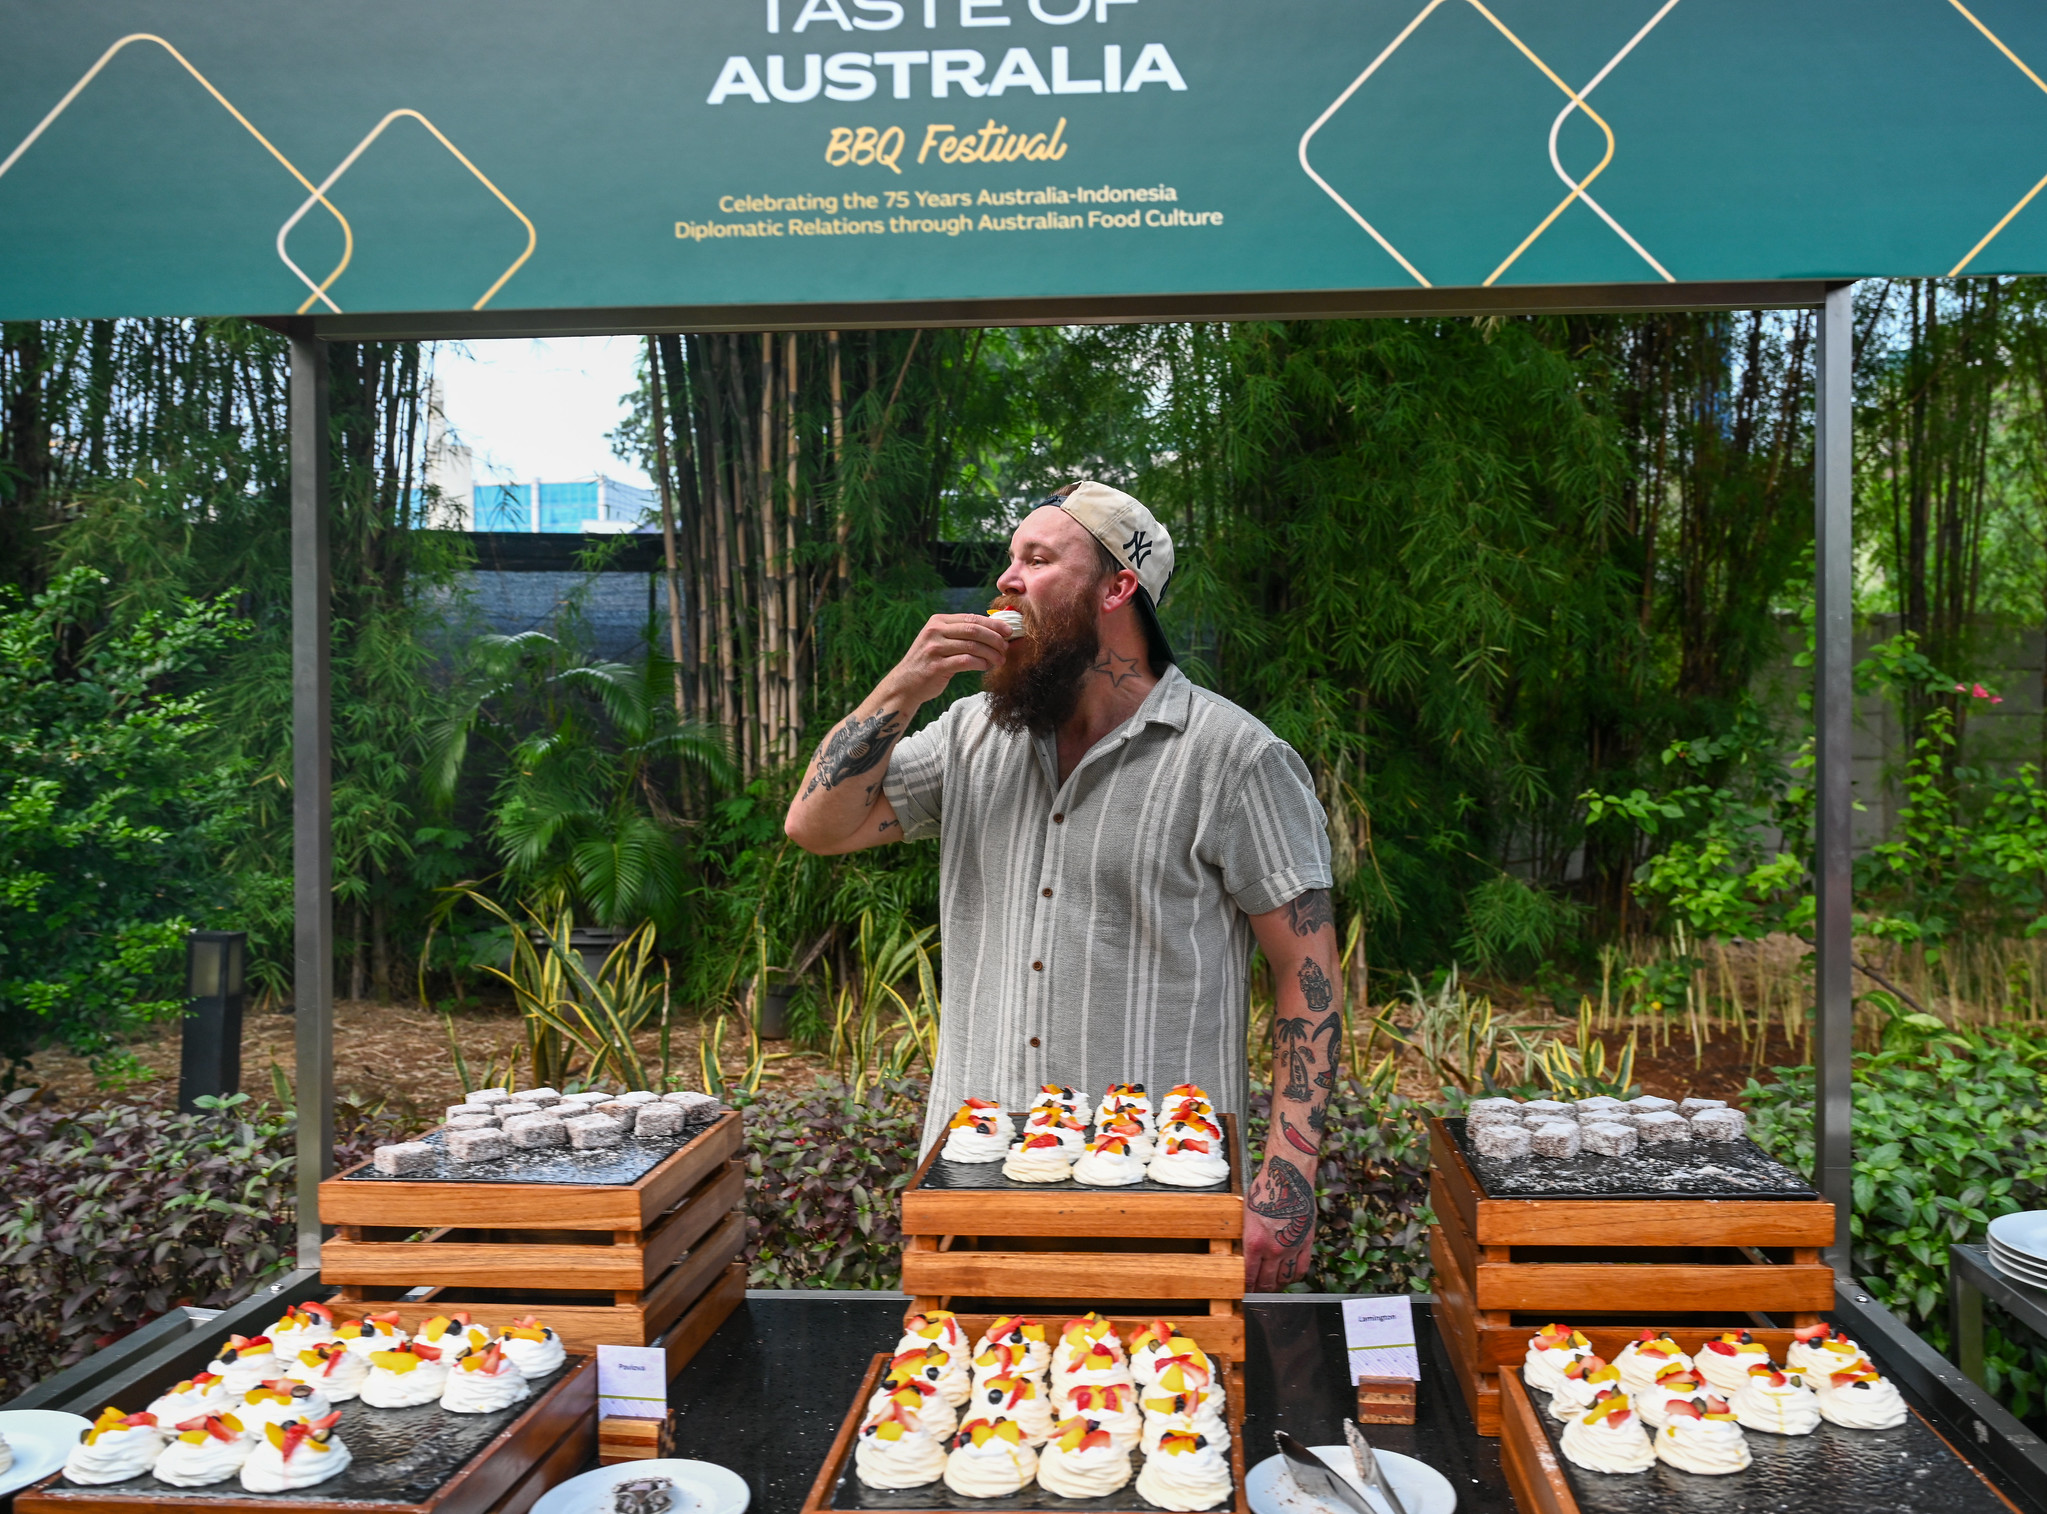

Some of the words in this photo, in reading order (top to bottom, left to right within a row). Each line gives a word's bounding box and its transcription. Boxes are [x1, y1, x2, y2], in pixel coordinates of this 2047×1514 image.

[706, 43, 1188, 104] AUSTRALIA
[825, 126, 904, 174] BBQ
[917, 117, 1068, 164] Festival
[719, 194, 838, 214] Celebrating
[843, 192, 879, 209] the
[883, 191, 910, 208] 75
[914, 189, 972, 207] Years
[977, 184, 1178, 206] Australia-Indonesia
[674, 219, 784, 241] Diplomatic
[788, 216, 885, 236] Relations
[889, 213, 973, 236] through
[978, 211, 1083, 231] Australian
[1087, 209, 1141, 228] Food
[1145, 207, 1224, 227] Culture
